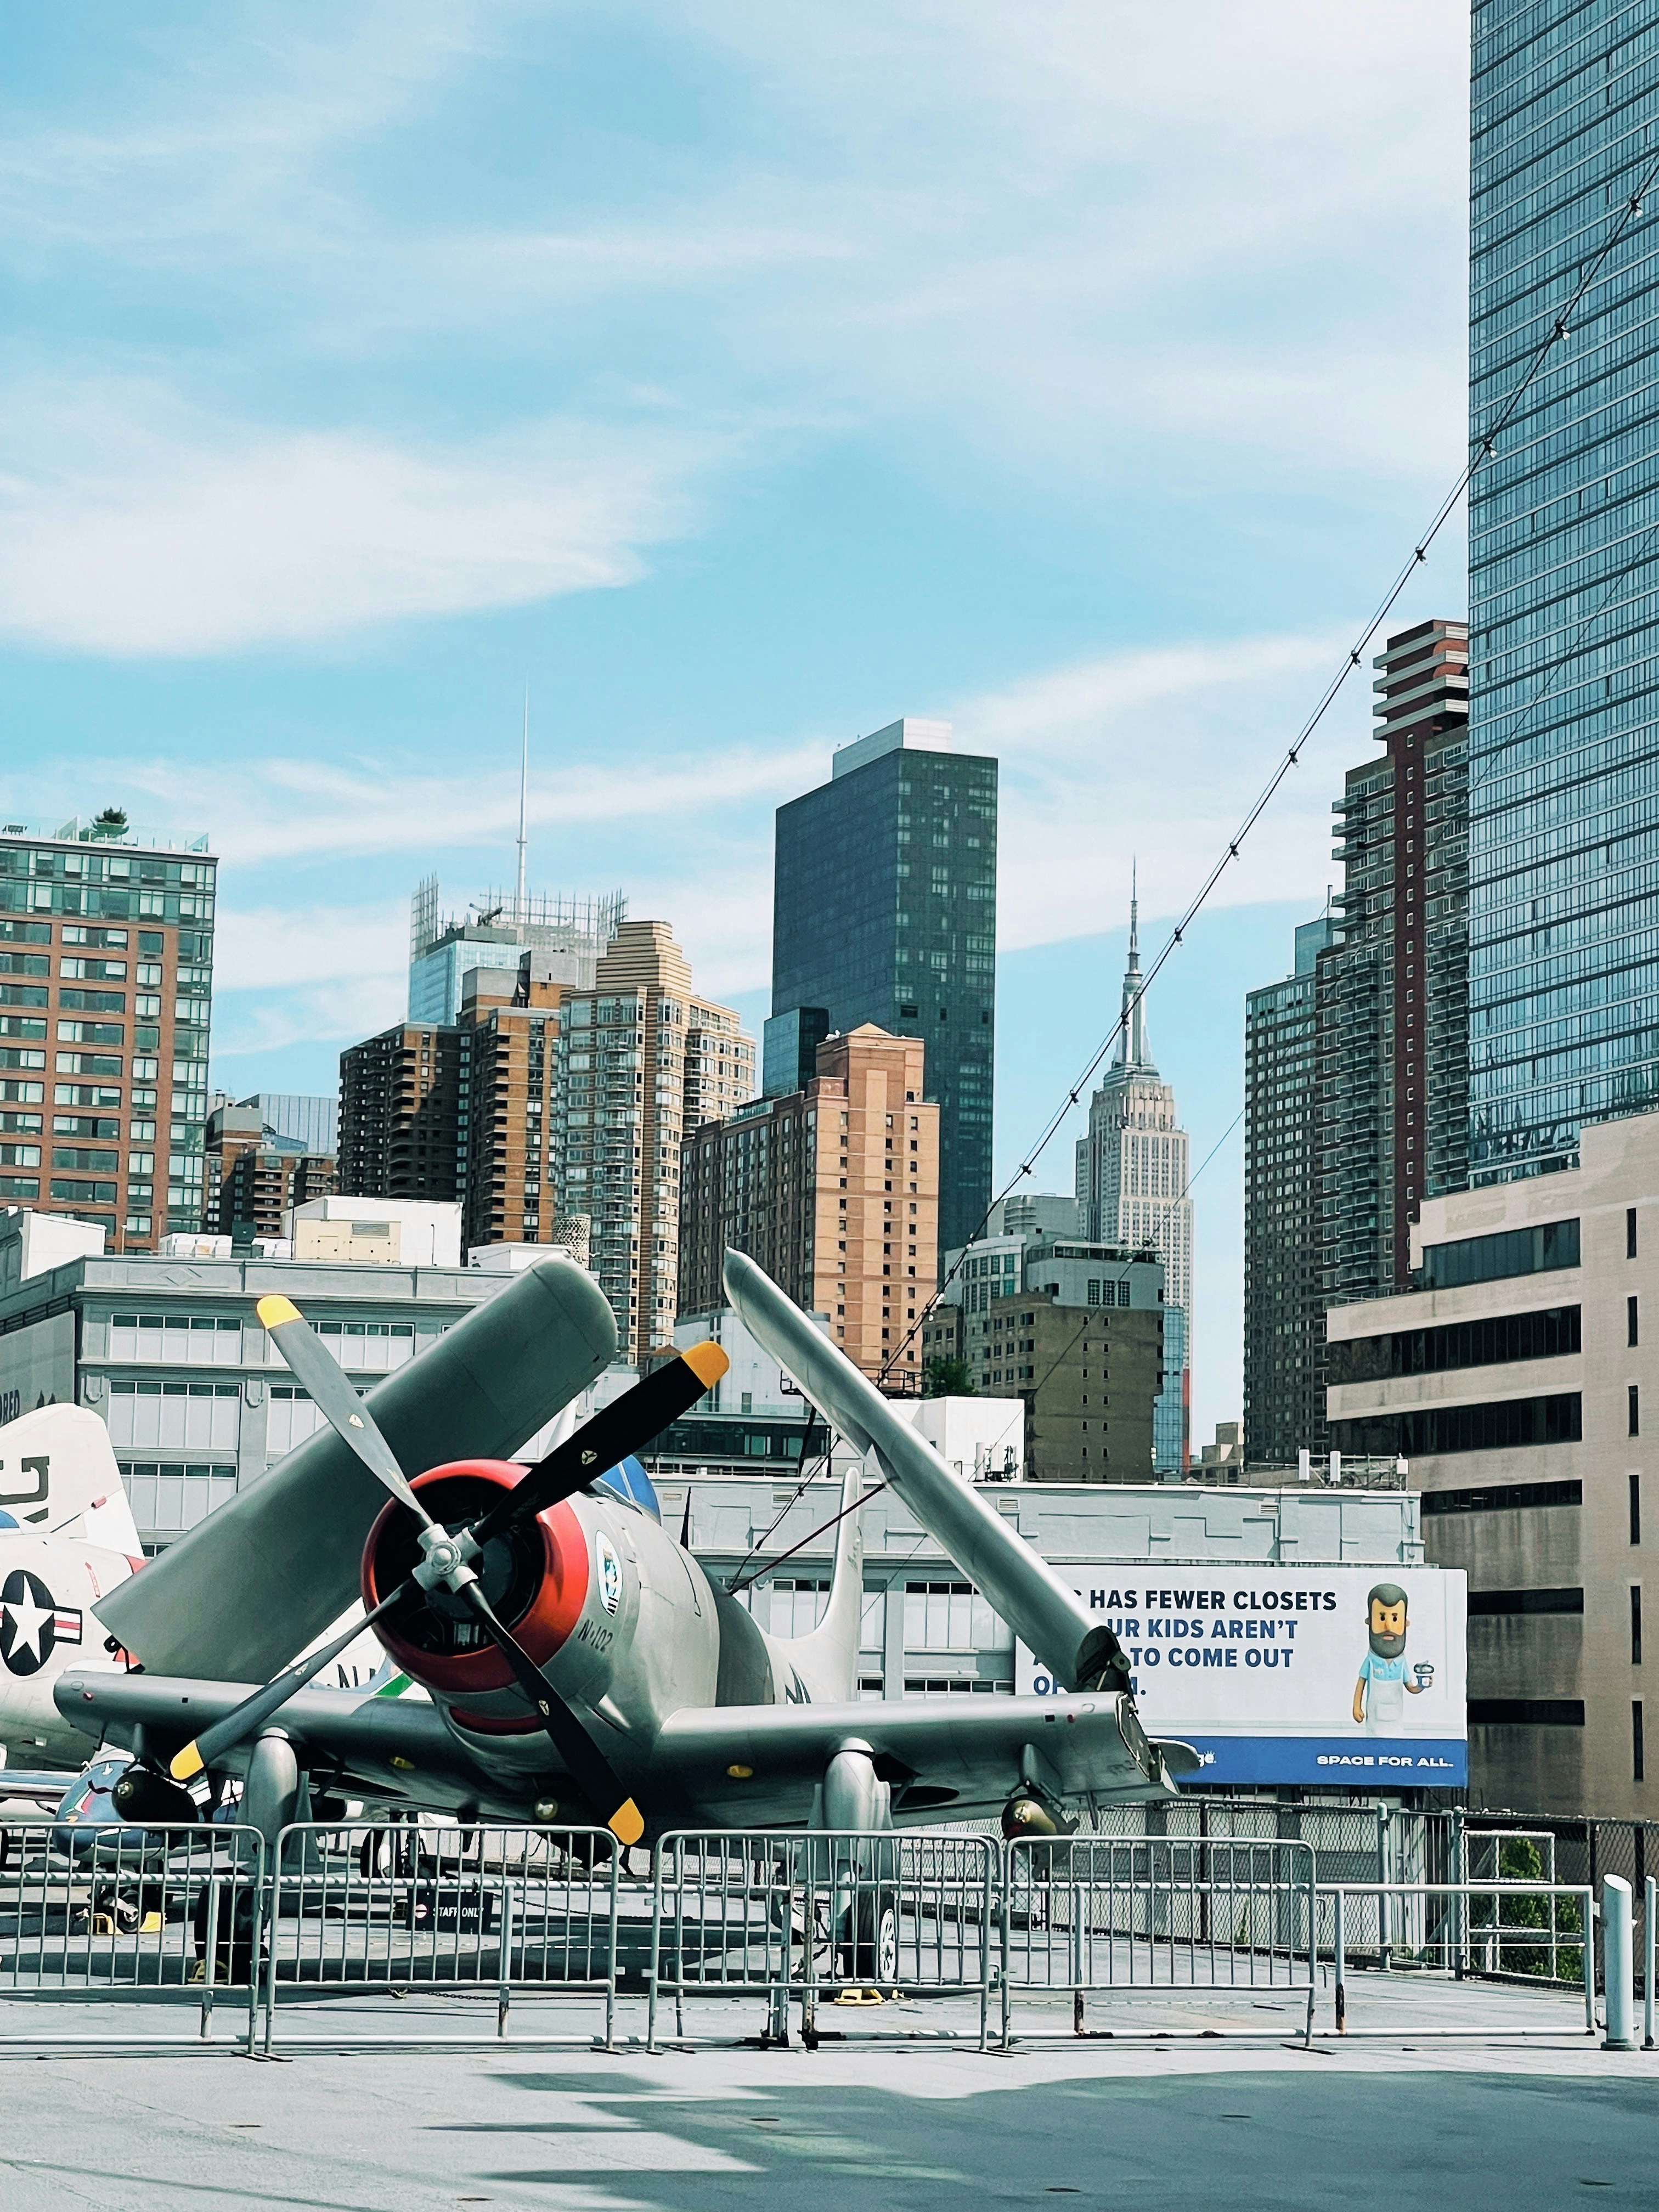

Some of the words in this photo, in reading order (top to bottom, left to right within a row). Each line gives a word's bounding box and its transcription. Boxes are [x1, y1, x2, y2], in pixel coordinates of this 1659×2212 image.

[1090, 1589, 1138, 1609] HAS
[1146, 1590, 1226, 1610] FEWER
[1233, 1591, 1336, 1611] CLOSETS
[1107, 1618, 1139, 1638] UR
[1148, 1618, 1204, 1638] KIDS
[1210, 1620, 1298, 1639] AREN’T
[1130, 1647, 1161, 1667] TO
[1168, 1647, 1237, 1667] COME
[1244, 1648, 1294, 1668] OUT
[1317, 1756, 1374, 1765] SPACE
[1378, 1757, 1413, 1767] FOR
[1417, 1757, 1454, 1767] ALL.
